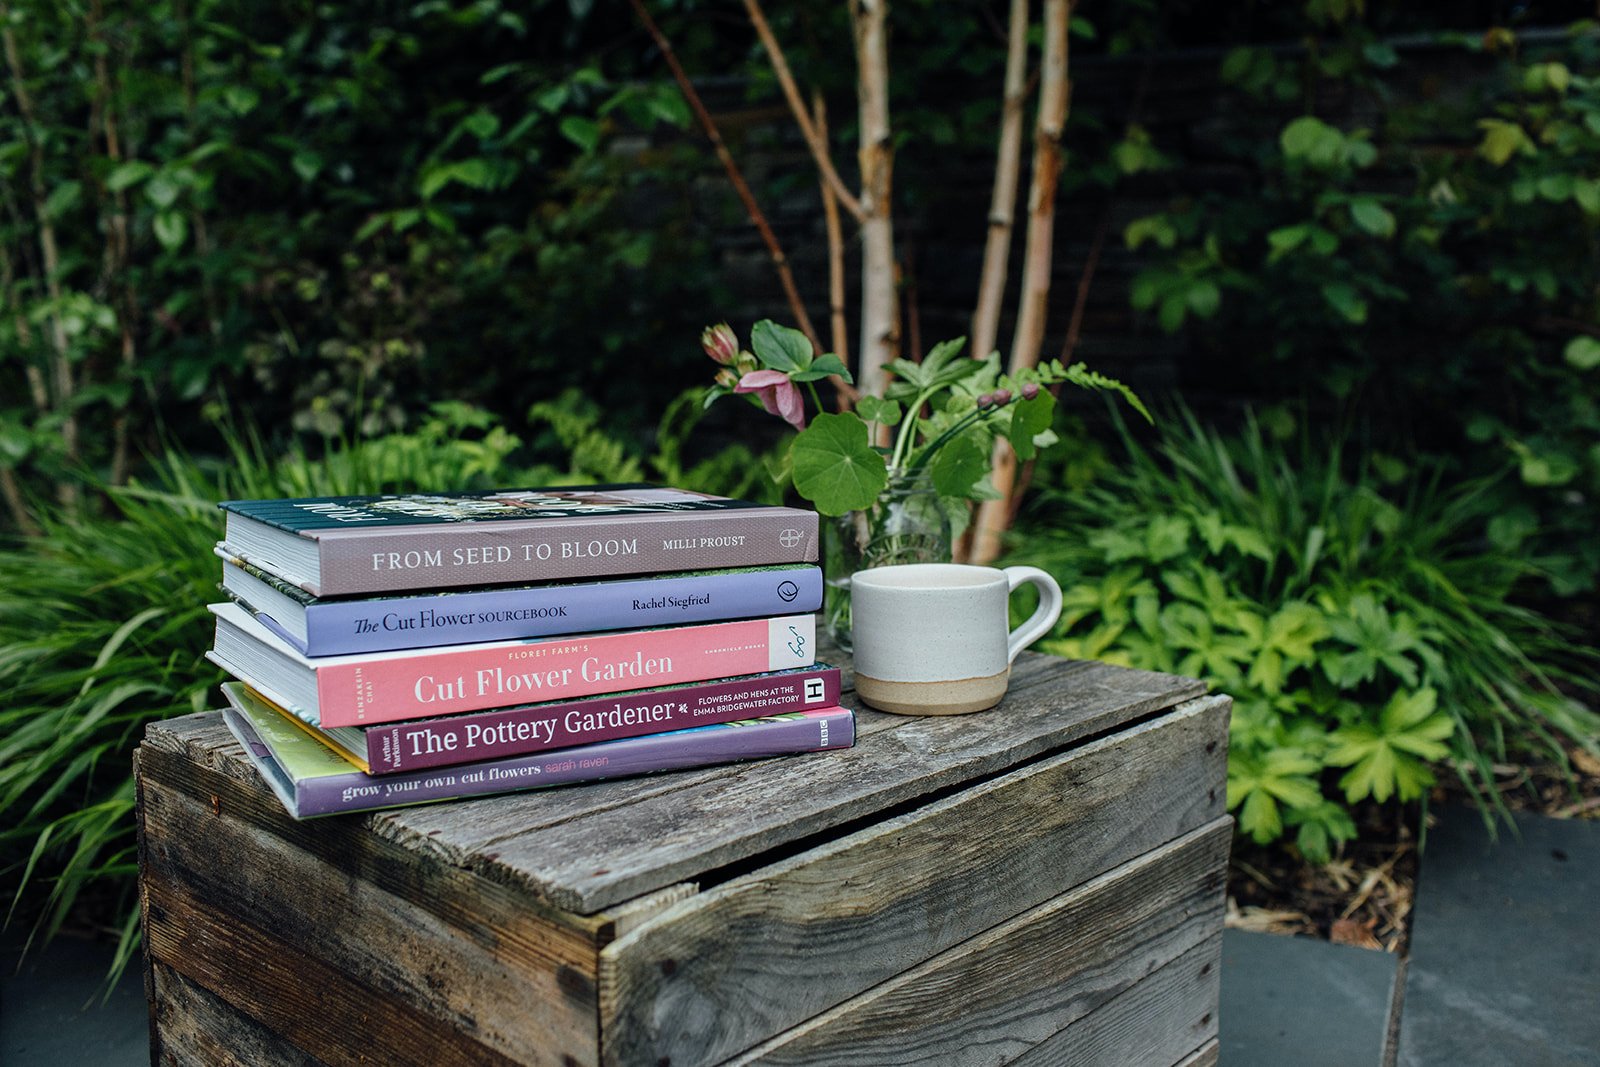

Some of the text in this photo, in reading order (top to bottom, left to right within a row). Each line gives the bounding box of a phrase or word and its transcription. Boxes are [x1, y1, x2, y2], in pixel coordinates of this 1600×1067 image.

[372, 538, 638, 571] FROM SEED TO BLOOM
[662, 535, 746, 550] MILLI PROUST
[632, 593, 710, 610] Rachel Siegfried
[355, 606, 568, 633] The Cut Flower SOURCEBOOK
[508, 645, 589, 660] FLORET FARM'S
[414, 651, 673, 703] Cut Flower Garden
[807, 682, 822, 699] H
[355, 667, 365, 719] BENZAKEIN
[366, 681, 374, 704] CHAI
[693, 694, 800, 717] EMMA BRIDGEWATER FACTORY
[698, 685, 794, 705] FLOWERS AND HENS AT THE
[406, 702, 675, 756] The Pottery Gardener
[819, 719, 829, 747] BBC
[382, 735, 391, 762] Arthur
[393, 728, 401, 768] Parkinson
[544, 755, 609, 773] sarah raven
[342, 762, 542, 802] grow your own cut flowers
